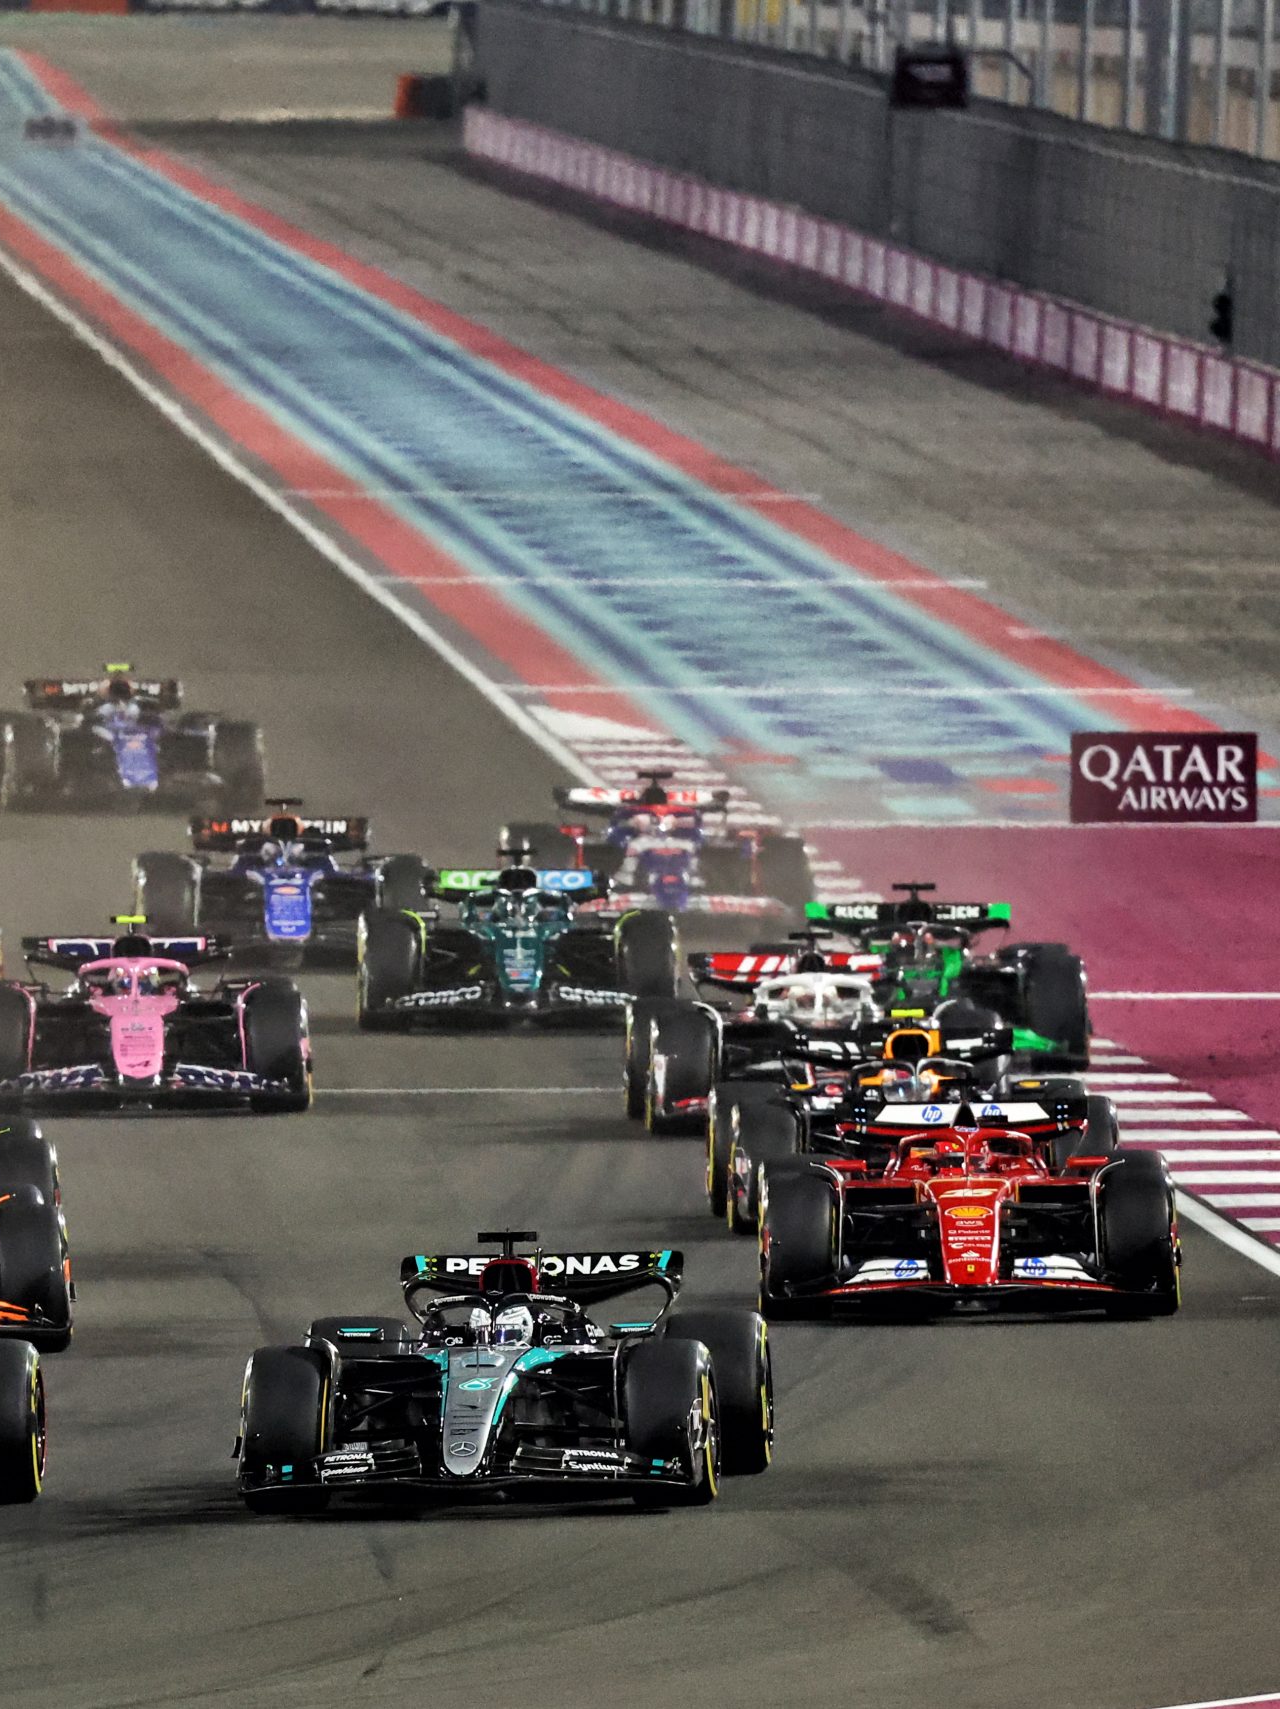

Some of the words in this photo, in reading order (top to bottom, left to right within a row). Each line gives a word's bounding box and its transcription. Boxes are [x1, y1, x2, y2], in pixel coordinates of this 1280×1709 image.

[1079, 743, 1245, 791] QATAR
[1118, 786, 1249, 811] AIRWAYS
[834, 904, 879, 920] KICK
[922, 1105, 943, 1123] hp
[893, 1259, 919, 1278] hp
[1022, 1257, 1048, 1276] hp
[323, 1452, 374, 1464] PETRONAS
[564, 1448, 620, 1460] PETRONAS
[568, 1460, 627, 1473] Syntium
